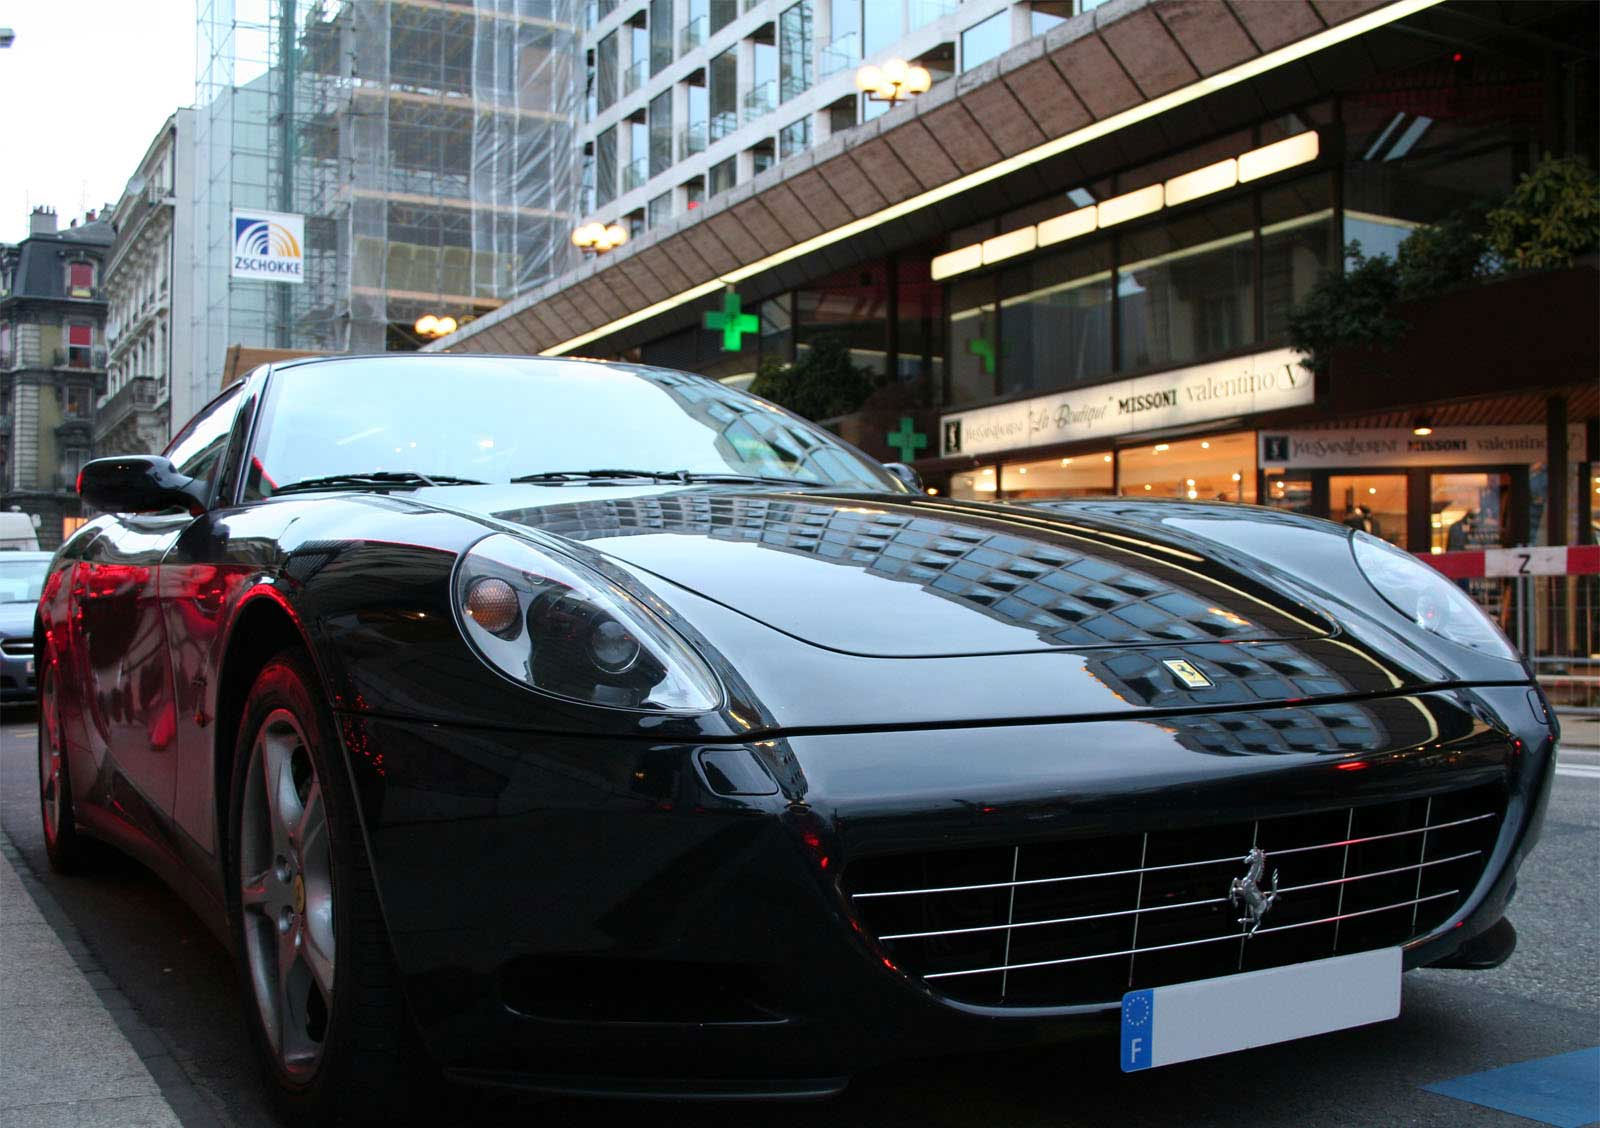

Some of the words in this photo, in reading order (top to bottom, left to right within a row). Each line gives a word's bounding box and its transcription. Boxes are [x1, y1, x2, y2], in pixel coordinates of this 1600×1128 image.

[235, 256, 300, 274] ZSCHOKKE
[1118, 388, 1178, 414] MISSONI
[1518, 554, 1531, 574] Z
[1131, 1038, 1142, 1063] F
